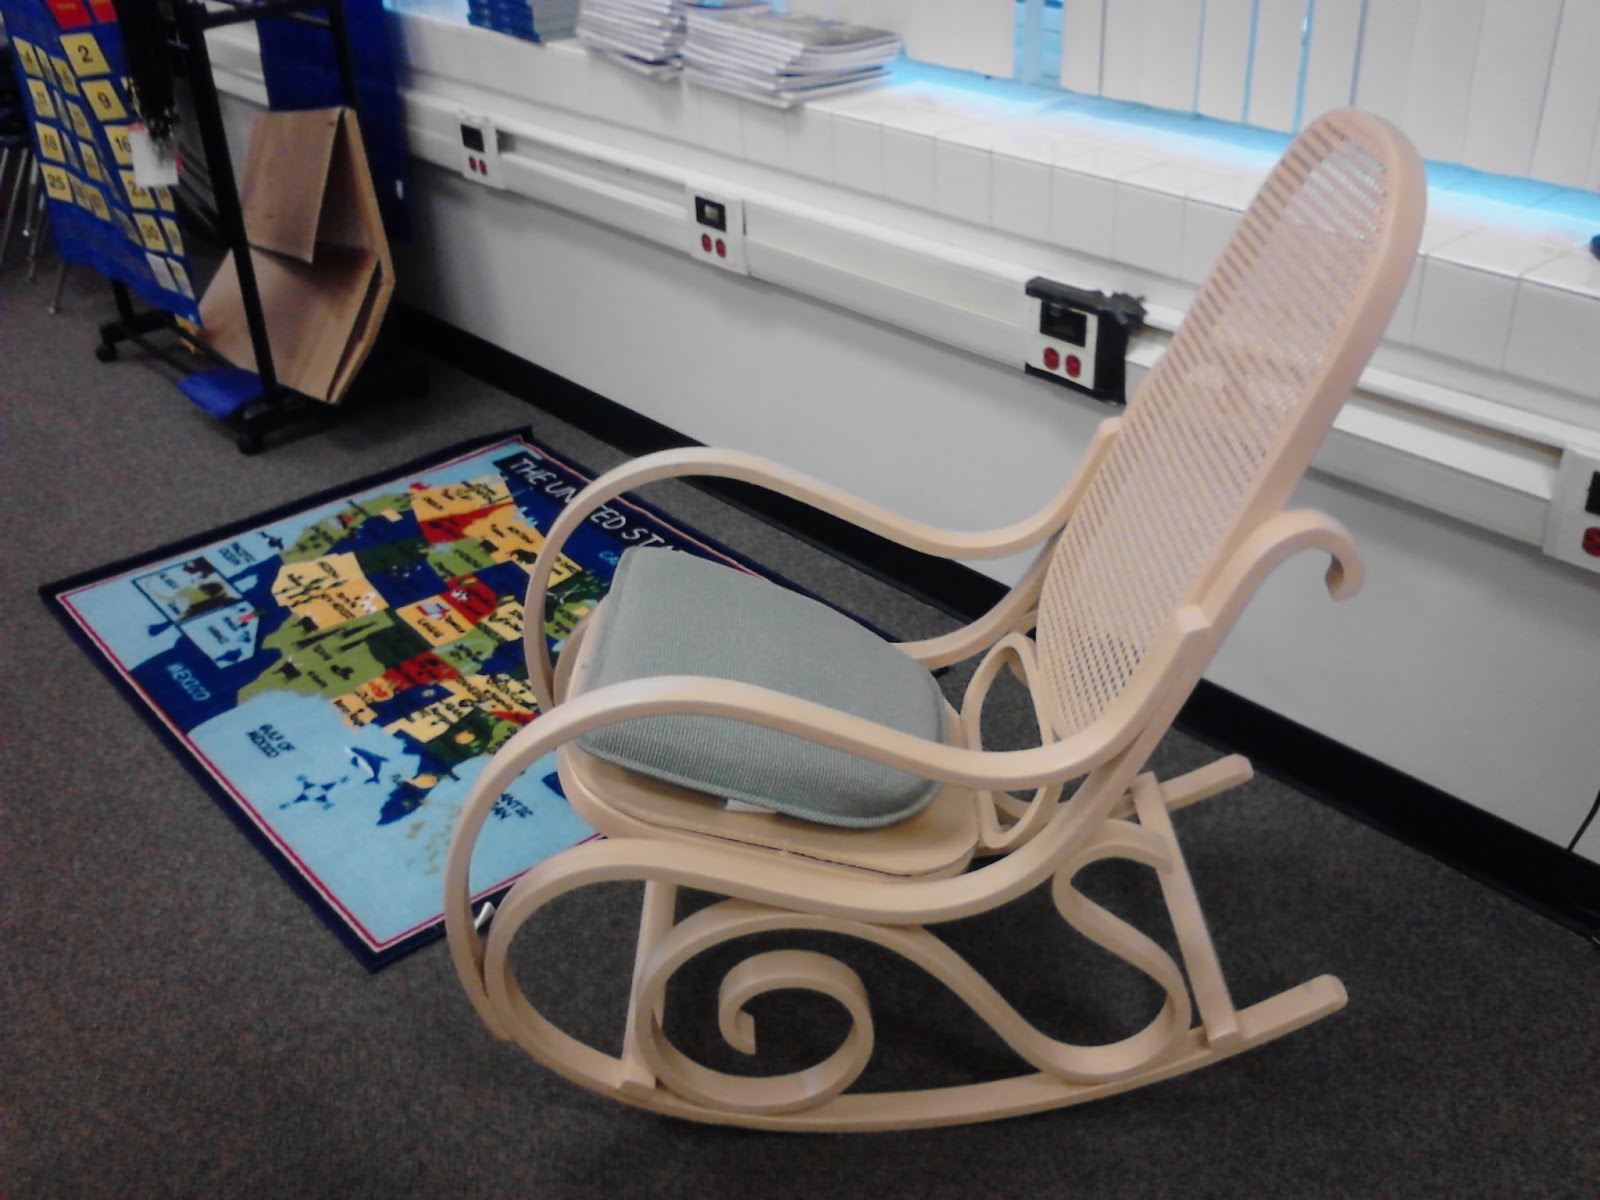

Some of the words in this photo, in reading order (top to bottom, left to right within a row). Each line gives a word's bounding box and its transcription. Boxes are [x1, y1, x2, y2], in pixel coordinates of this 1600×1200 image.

[77, 45, 93, 63] 2
[97, 91, 112, 110] 9
[510, 458, 557, 485] THE
[167, 662, 211, 701] MEXICO
